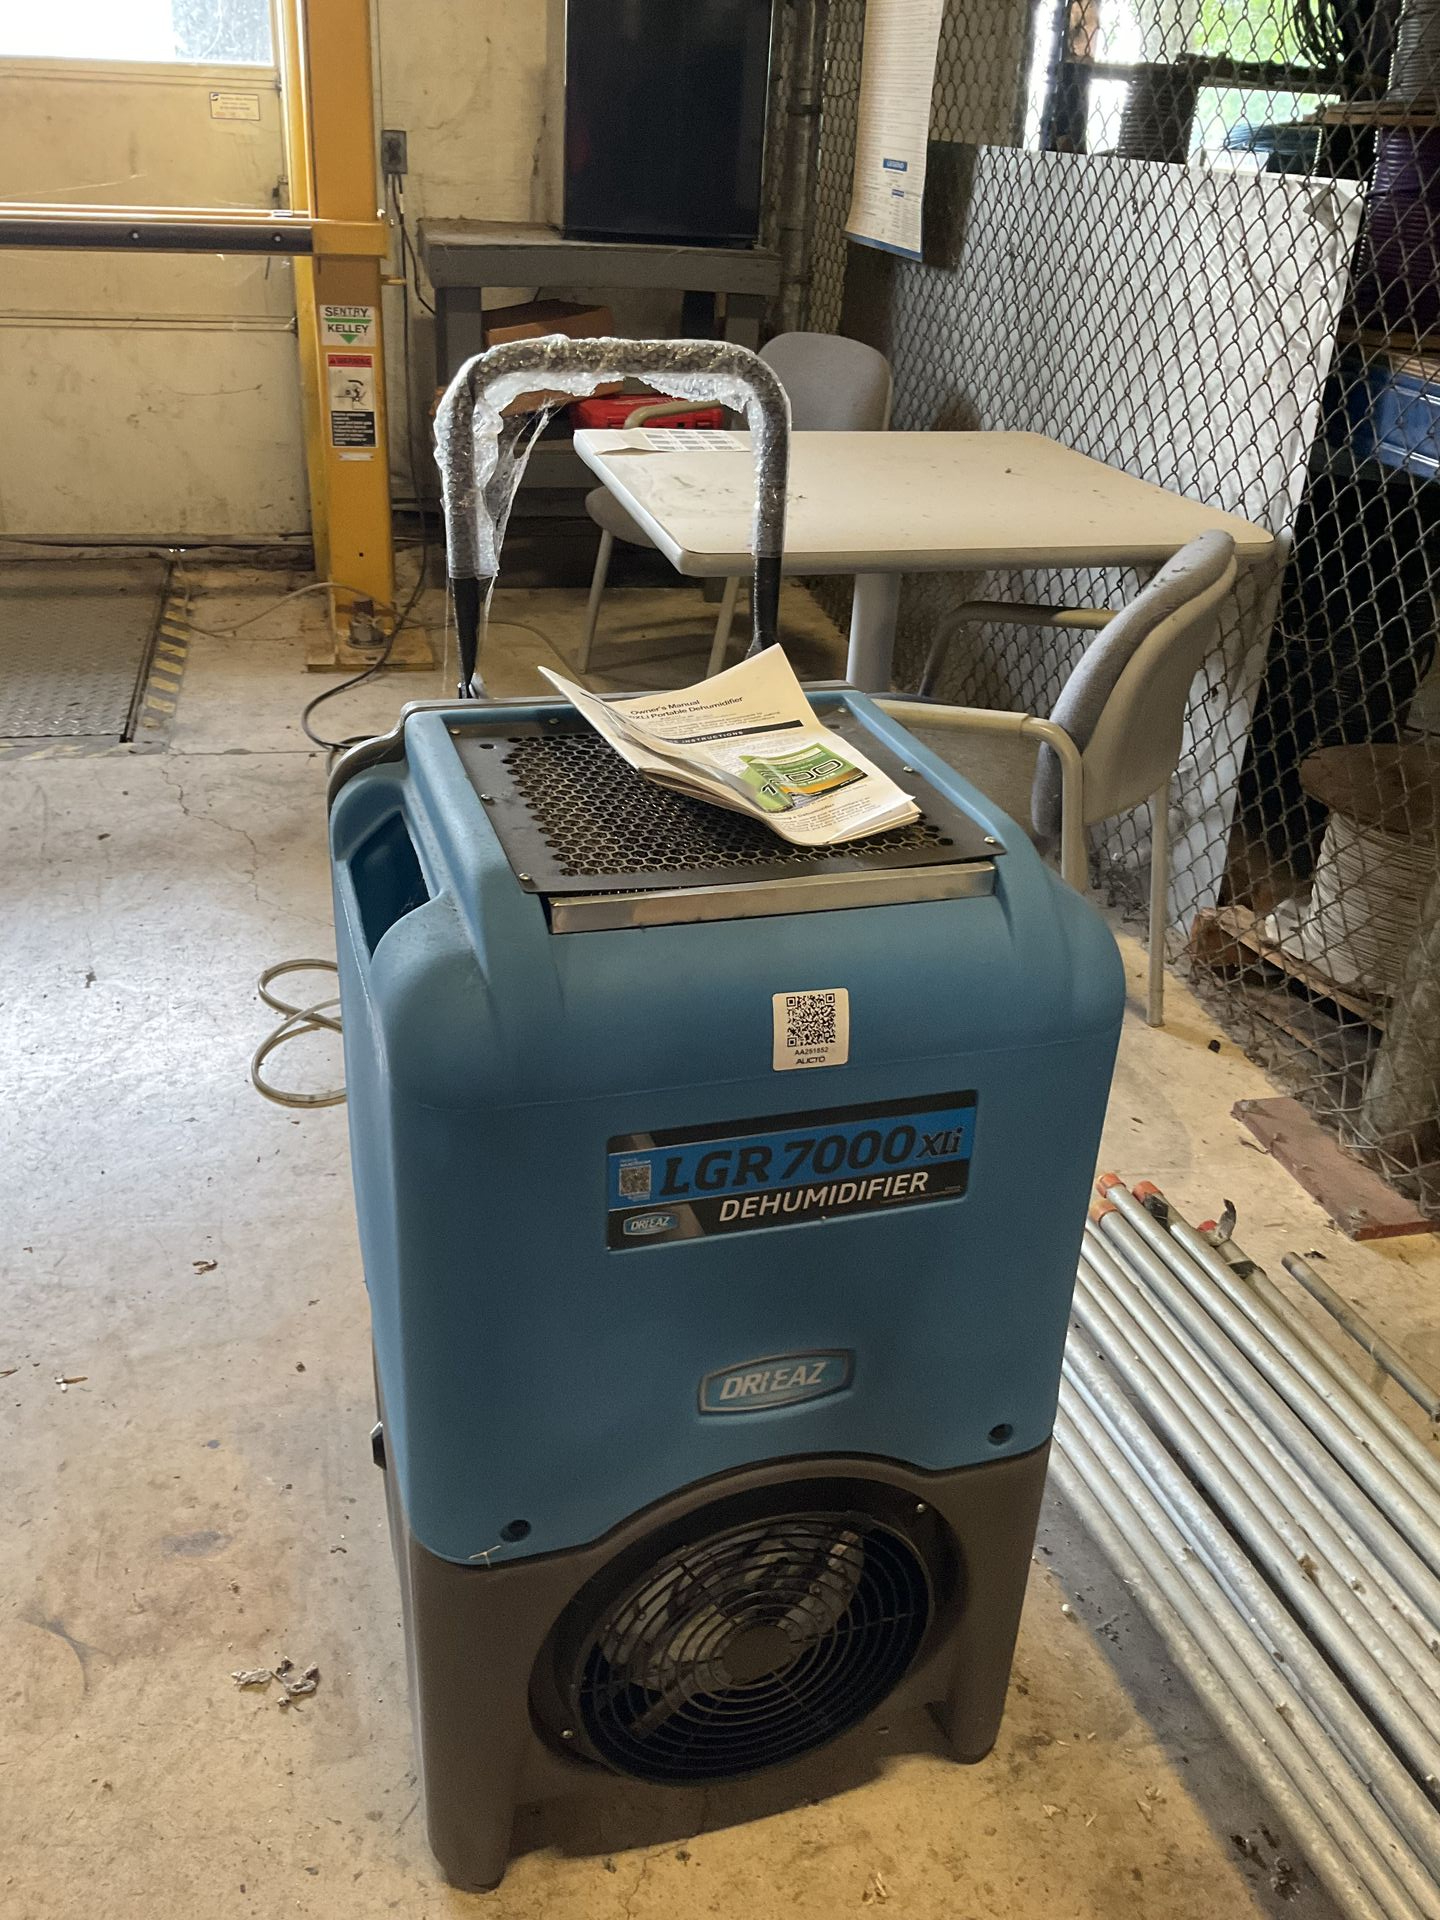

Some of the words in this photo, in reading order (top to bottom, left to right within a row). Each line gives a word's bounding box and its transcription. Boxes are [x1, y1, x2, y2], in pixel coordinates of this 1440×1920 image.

[325, 306, 369, 318] SENTRY
[327, 324, 369, 334] KELLEY
[630, 705, 667, 716] Owner's
[667, 699, 700, 710] Manual
[650, 708, 688, 720] Portable
[688, 696, 744, 713] Dehumidifier
[682, 730, 744, 744] INSTRUCTIONS
[795, 1056, 826, 1065] AUCTO
[660, 1146, 772, 1196] LGR
[781, 1124, 917, 1180] 7000
[719, 1171, 929, 1222] DEHUMIDIFIER
